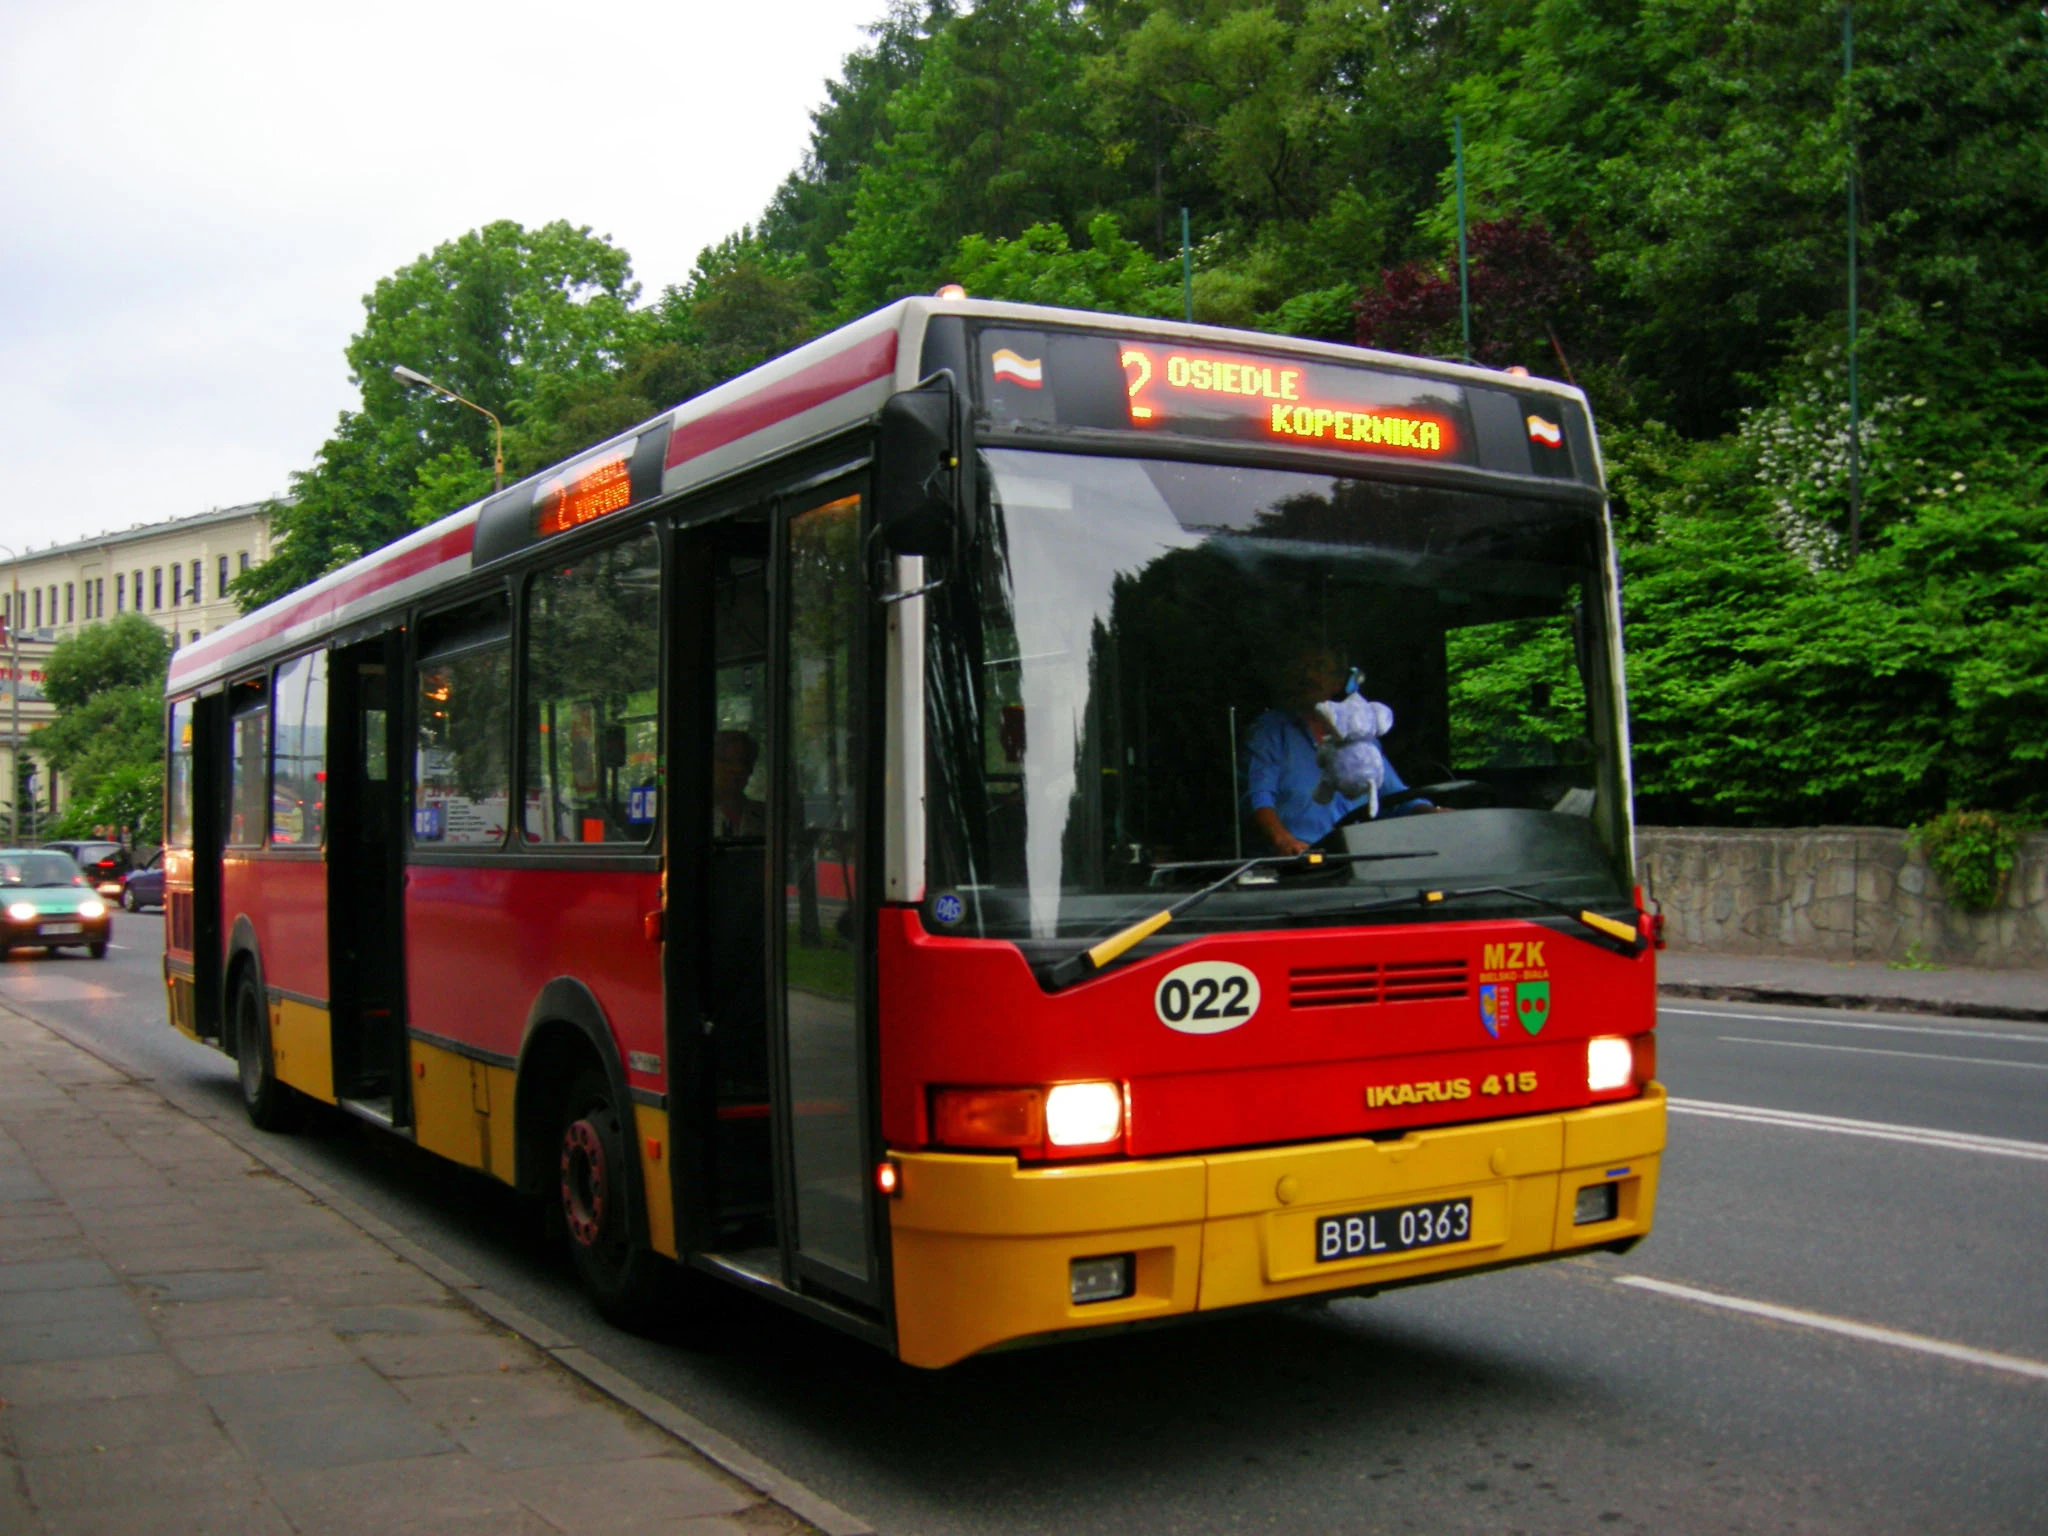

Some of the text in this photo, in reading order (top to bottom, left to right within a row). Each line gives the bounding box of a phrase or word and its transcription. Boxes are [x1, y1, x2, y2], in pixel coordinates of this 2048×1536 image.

[1121, 351, 1299, 418] 2 OSIEDLE
[1271, 403, 1440, 450] KOPERNIKA
[1483, 941, 1546, 970] MZK
[1160, 975, 1251, 1022] 022
[1366, 1071, 1538, 1108] IKARUS 415
[1322, 1202, 1470, 1258] BBL 0363
